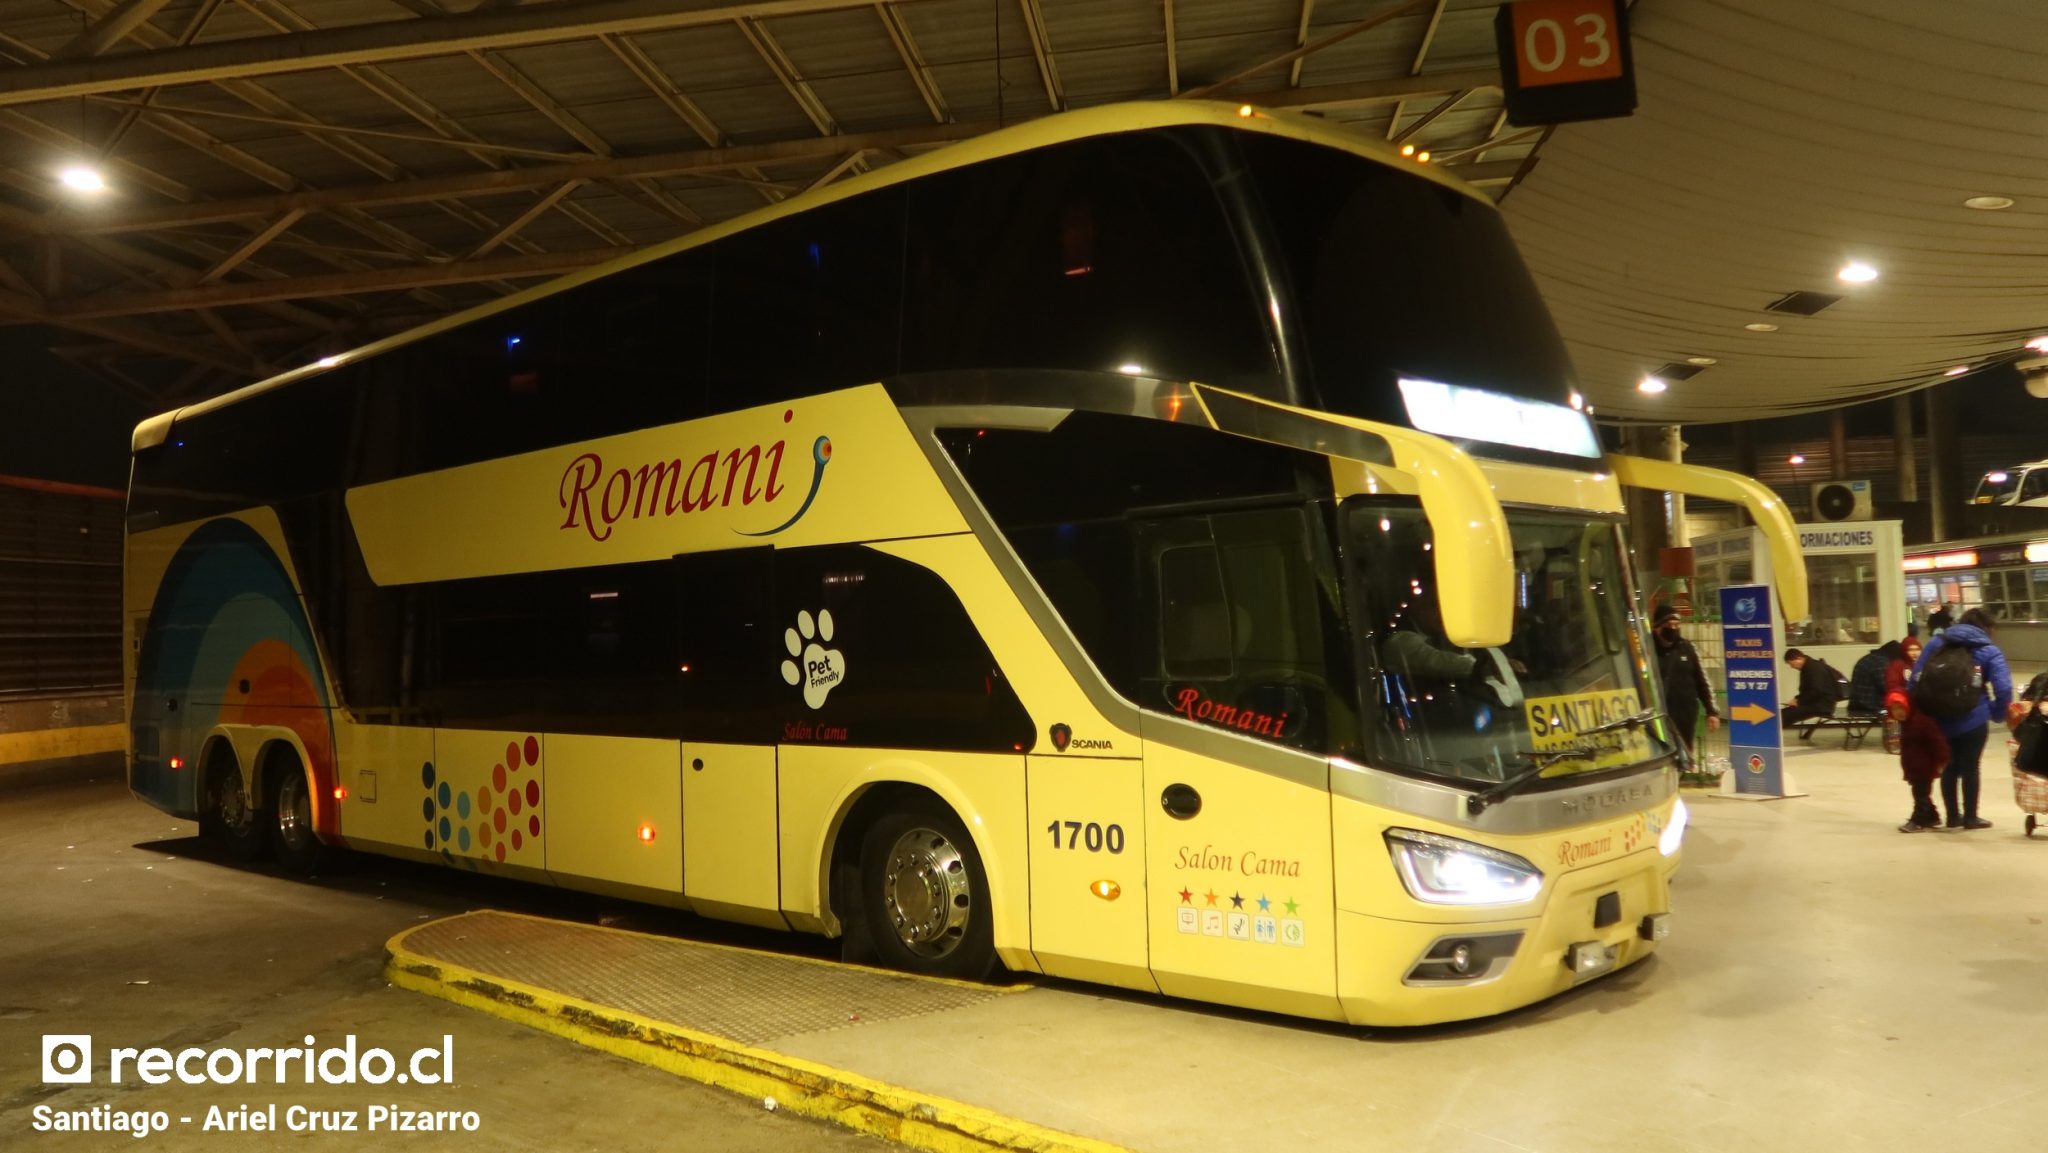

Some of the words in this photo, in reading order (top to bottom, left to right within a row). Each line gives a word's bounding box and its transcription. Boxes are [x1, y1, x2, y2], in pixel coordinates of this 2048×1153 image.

[1524, 12, 1612, 73] 03
[559, 409, 793, 542] Romani
[1800, 530, 1874, 548] ORMACIONES
[1726, 650, 1775, 659] OFICIALES
[808, 655, 832, 678] Pet
[1729, 670, 1774, 679] ANDENES
[810, 671, 840, 689] Friendly
[1748, 682, 1757, 690] Y
[1756, 682, 1769, 690] 27
[1175, 688, 1288, 738] Romani
[1531, 694, 1641, 738] SANTIAGO
[815, 721, 848, 741] Cama
[1071, 739, 1113, 750] SCANIA
[1047, 820, 1125, 855] 1700
[1558, 828, 1613, 868] Romani
[1174, 844, 1233, 872] Salon
[1240, 851, 1301, 878] Cama
